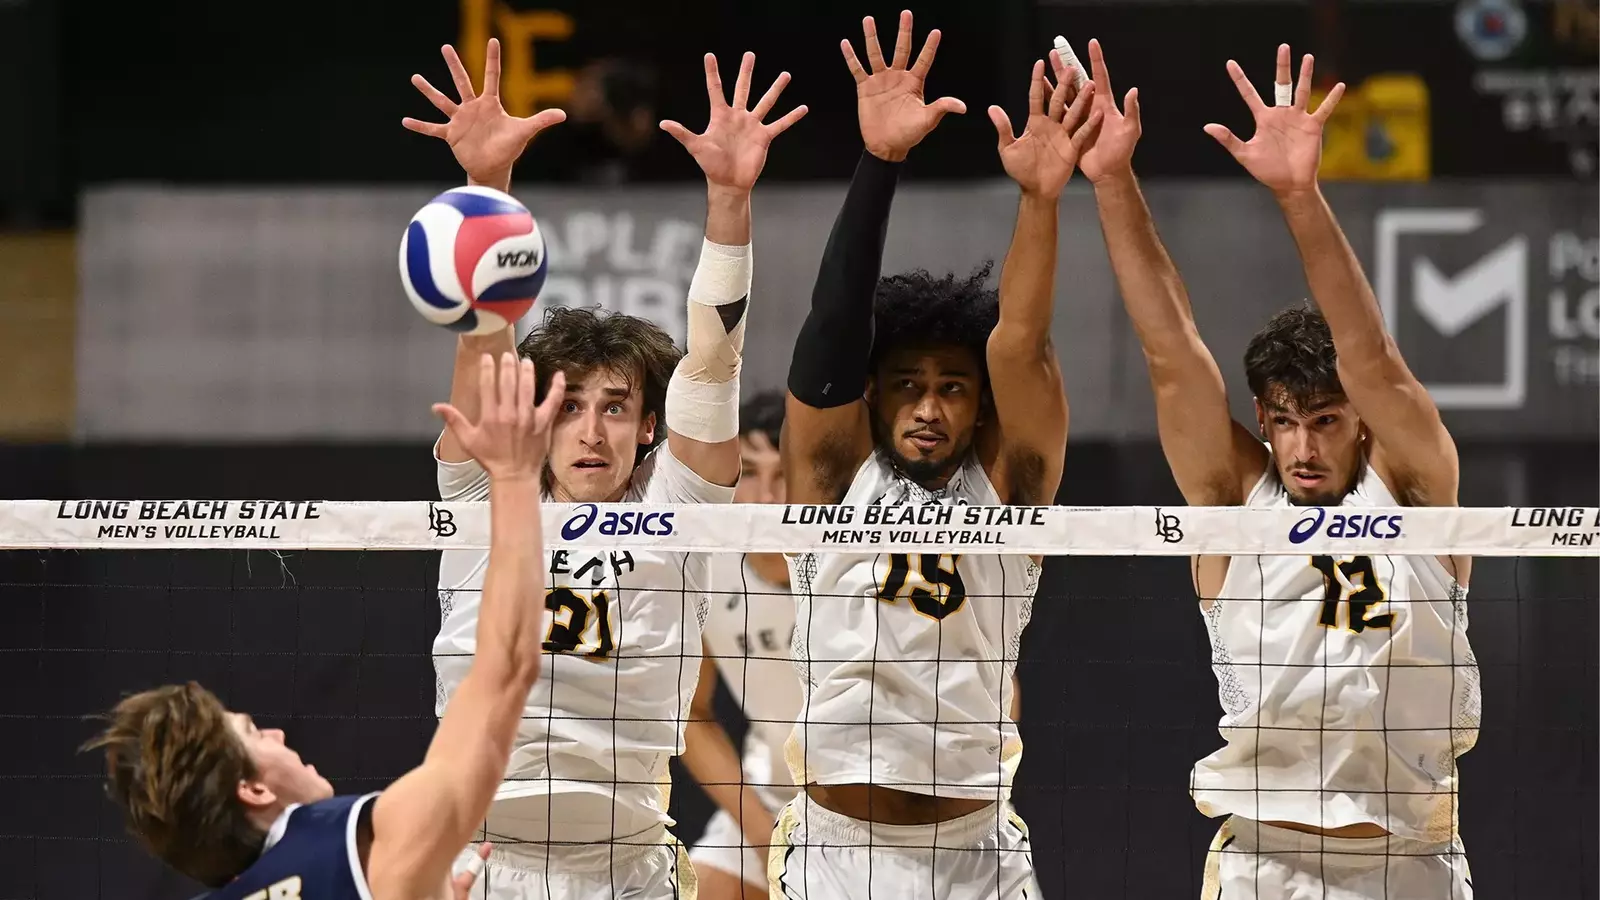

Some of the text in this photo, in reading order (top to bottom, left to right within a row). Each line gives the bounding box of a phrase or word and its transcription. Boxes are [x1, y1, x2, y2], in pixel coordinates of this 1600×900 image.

[497, 250, 539, 268] NCAA
[57, 500, 322, 520] LONG BEACH STATE
[781, 505, 1050, 526] LONG BEACH STATE
[1511, 508, 1585, 527] LONG
[97, 525, 281, 539] MEN'S VOLLEYBALL
[599, 511, 676, 536] asics
[1326, 514, 1403, 540] asics
[821, 530, 1006, 545] MEN'S VOLLEYBALL
[1309, 555, 1398, 634] 12
